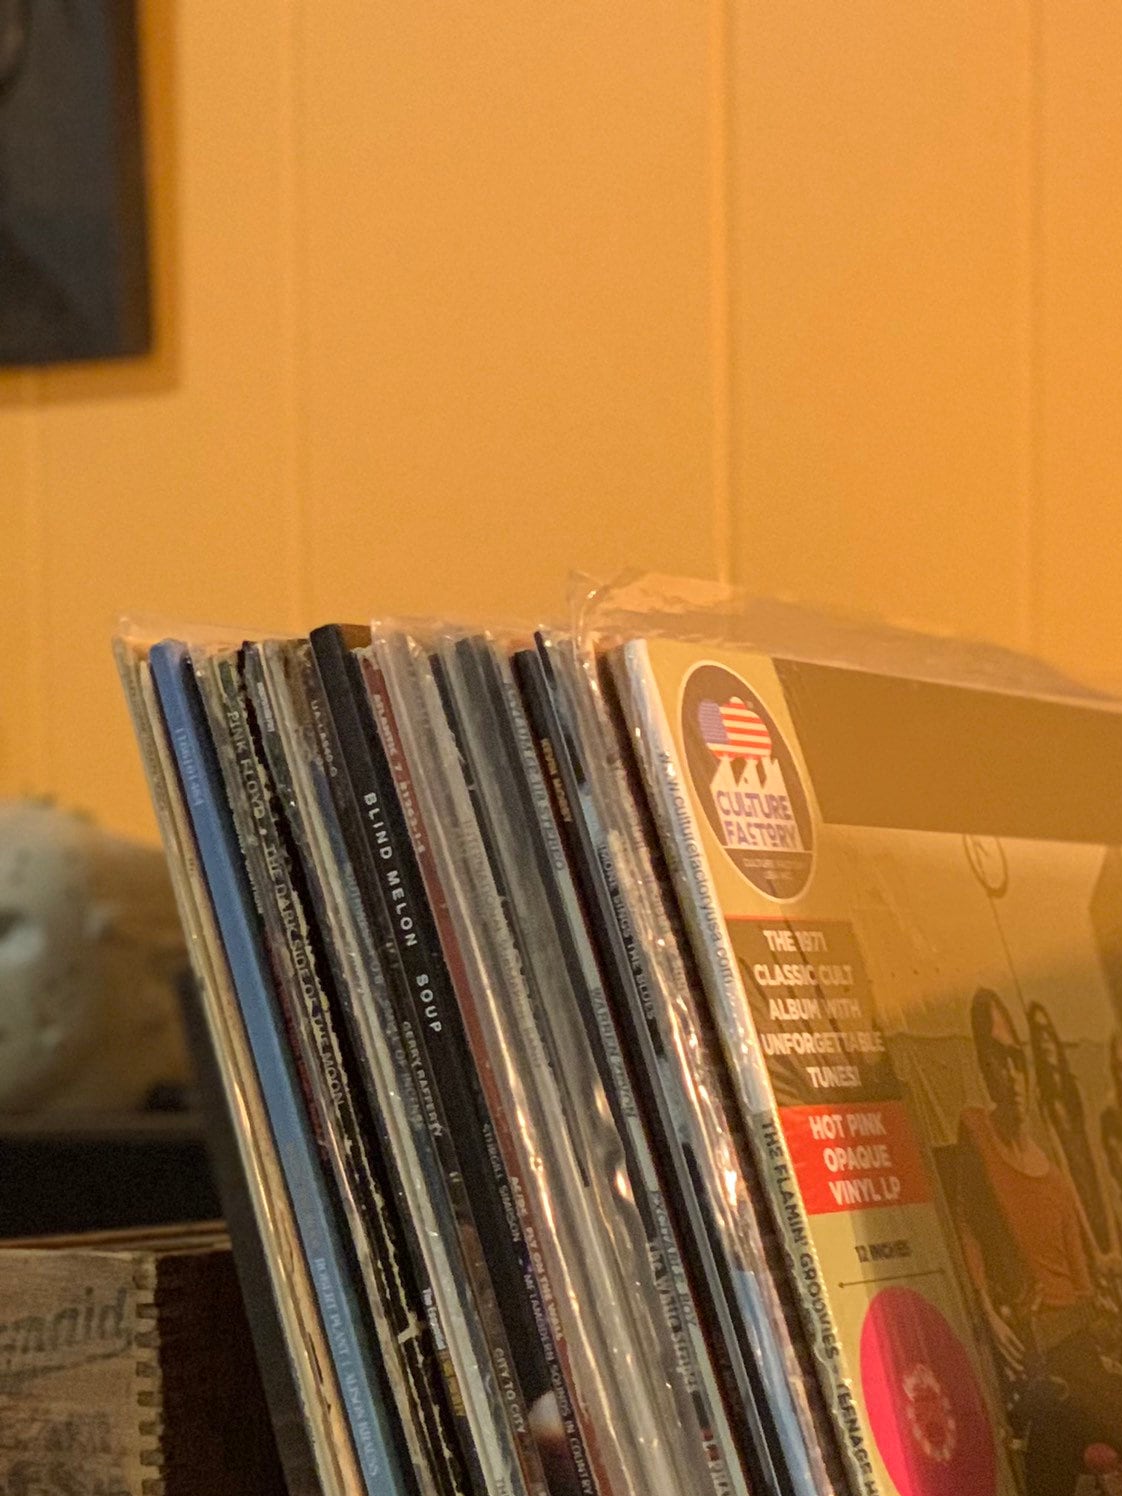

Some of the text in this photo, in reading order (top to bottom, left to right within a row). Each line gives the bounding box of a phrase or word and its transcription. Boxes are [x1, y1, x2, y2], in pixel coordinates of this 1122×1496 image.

[372, 692, 398, 756] ATLANTIC
[716, 790, 793, 820] CULTURE
[724, 820, 800, 849] FACTORY
[226, 710, 248, 753] PINK
[239, 757, 265, 819] FLOYD
[264, 844, 283, 878] THE
[274, 883, 298, 935] DARK
[290, 939, 311, 981] SIDE
[301, 983, 318, 1010] OF
[310, 1015, 329, 1048] THE
[320, 1051, 344, 1106] MOON
[363, 791, 442, 1034] BLIND MELON SOUP
[763, 930, 828, 952] THE 1971
[625, 942, 642, 971] THE
[634, 973, 657, 1020] BLUES
[754, 964, 853, 986] CLASSIC CULT
[769, 998, 861, 1020] ALBUM WITH
[761, 1032, 886, 1055] UNFORGETTABLE
[399, 1020, 443, 1138] GERRY RAFFERTY
[809, 1112, 887, 1140] HOT PINK
[480, 1123, 504, 1180] STURGILL
[589, 986, 620, 1057] WARREN
[648, 1189, 685, 1284] EXCITABLE
[678, 1291, 697, 1328] BOY
[824, 1145, 893, 1173] OPAQUE
[497, 1184, 521, 1243] SIMPSON
[829, 1176, 901, 1206] VINYL LP
[524, 1226, 537, 1248] FLY
[531, 1250, 545, 1274] ON
[538, 1276, 553, 1301] THE
[758, 1117, 783, 1160] THE
[772, 1163, 809, 1249] FLAMIN'
[797, 1252, 840, 1360] GROOVIES
[834, 1381, 873, 1476] TEENAGE
[522, 1272, 555, 1361] METAMODERN
[545, 1302, 564, 1341] WALL
[313, 1256, 381, 1477] ROBERT PLANT ALISON KRAUSS
[493, 1346, 526, 1434] CITY TO CITY
[548, 1364, 571, 1417] SOUNDS
[563, 1419, 576, 1434] IN
[568, 1436, 593, 1496] COUNTRY
